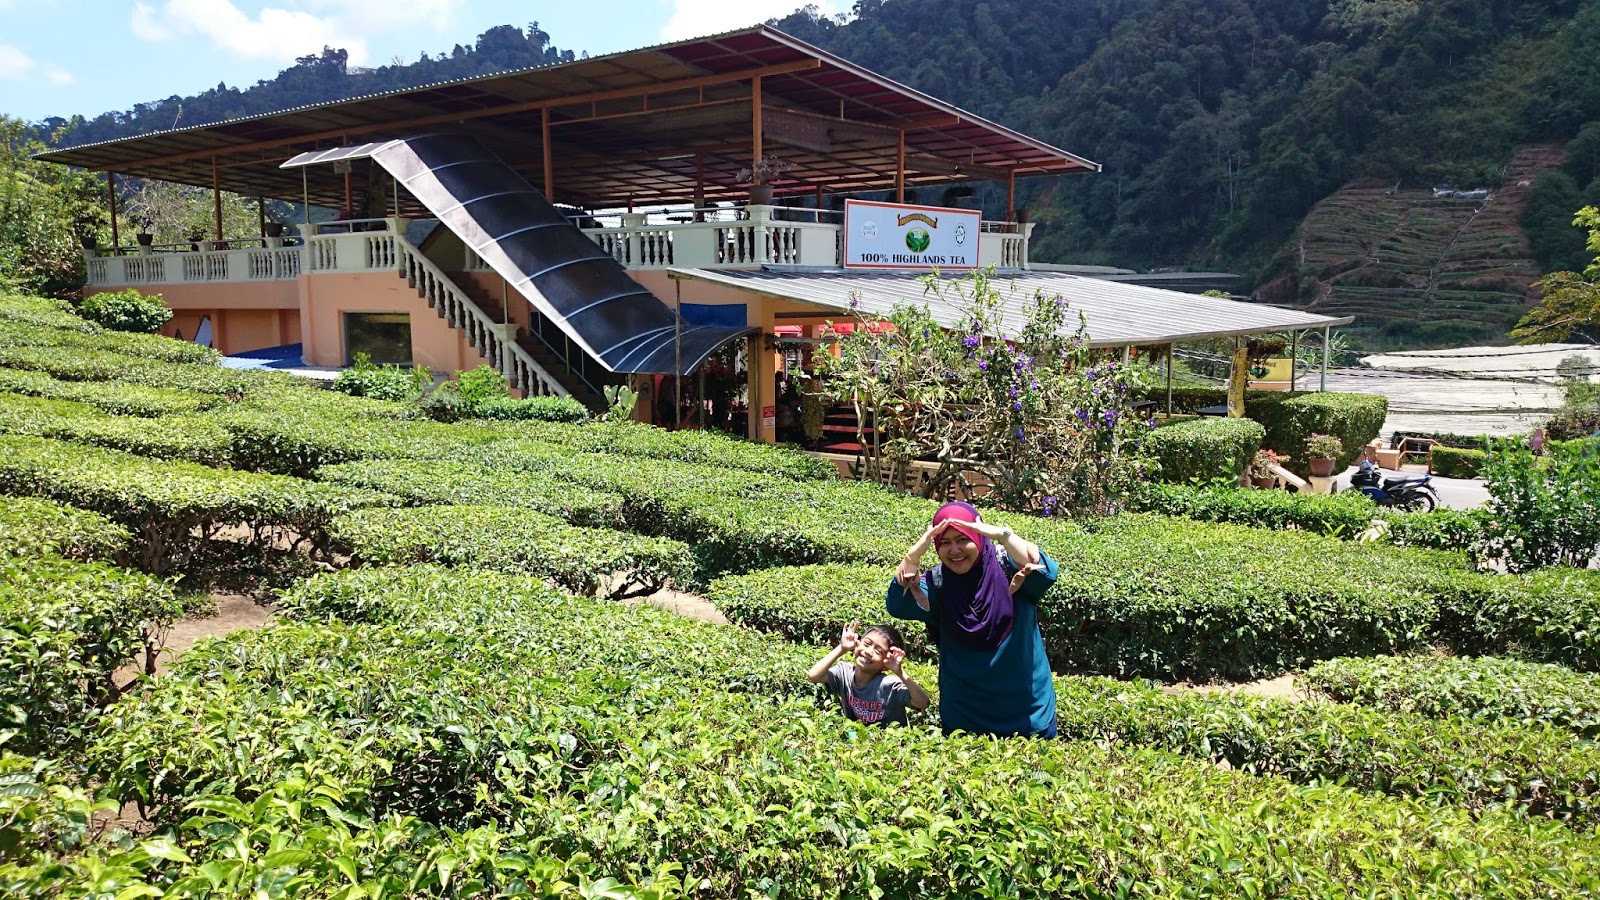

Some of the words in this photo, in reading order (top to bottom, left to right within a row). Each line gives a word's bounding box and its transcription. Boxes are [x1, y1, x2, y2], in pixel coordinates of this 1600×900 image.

[861, 253, 888, 262] 100%
[892, 254, 946, 264] HIGHLANDS
[950, 256, 966, 264] TEA
